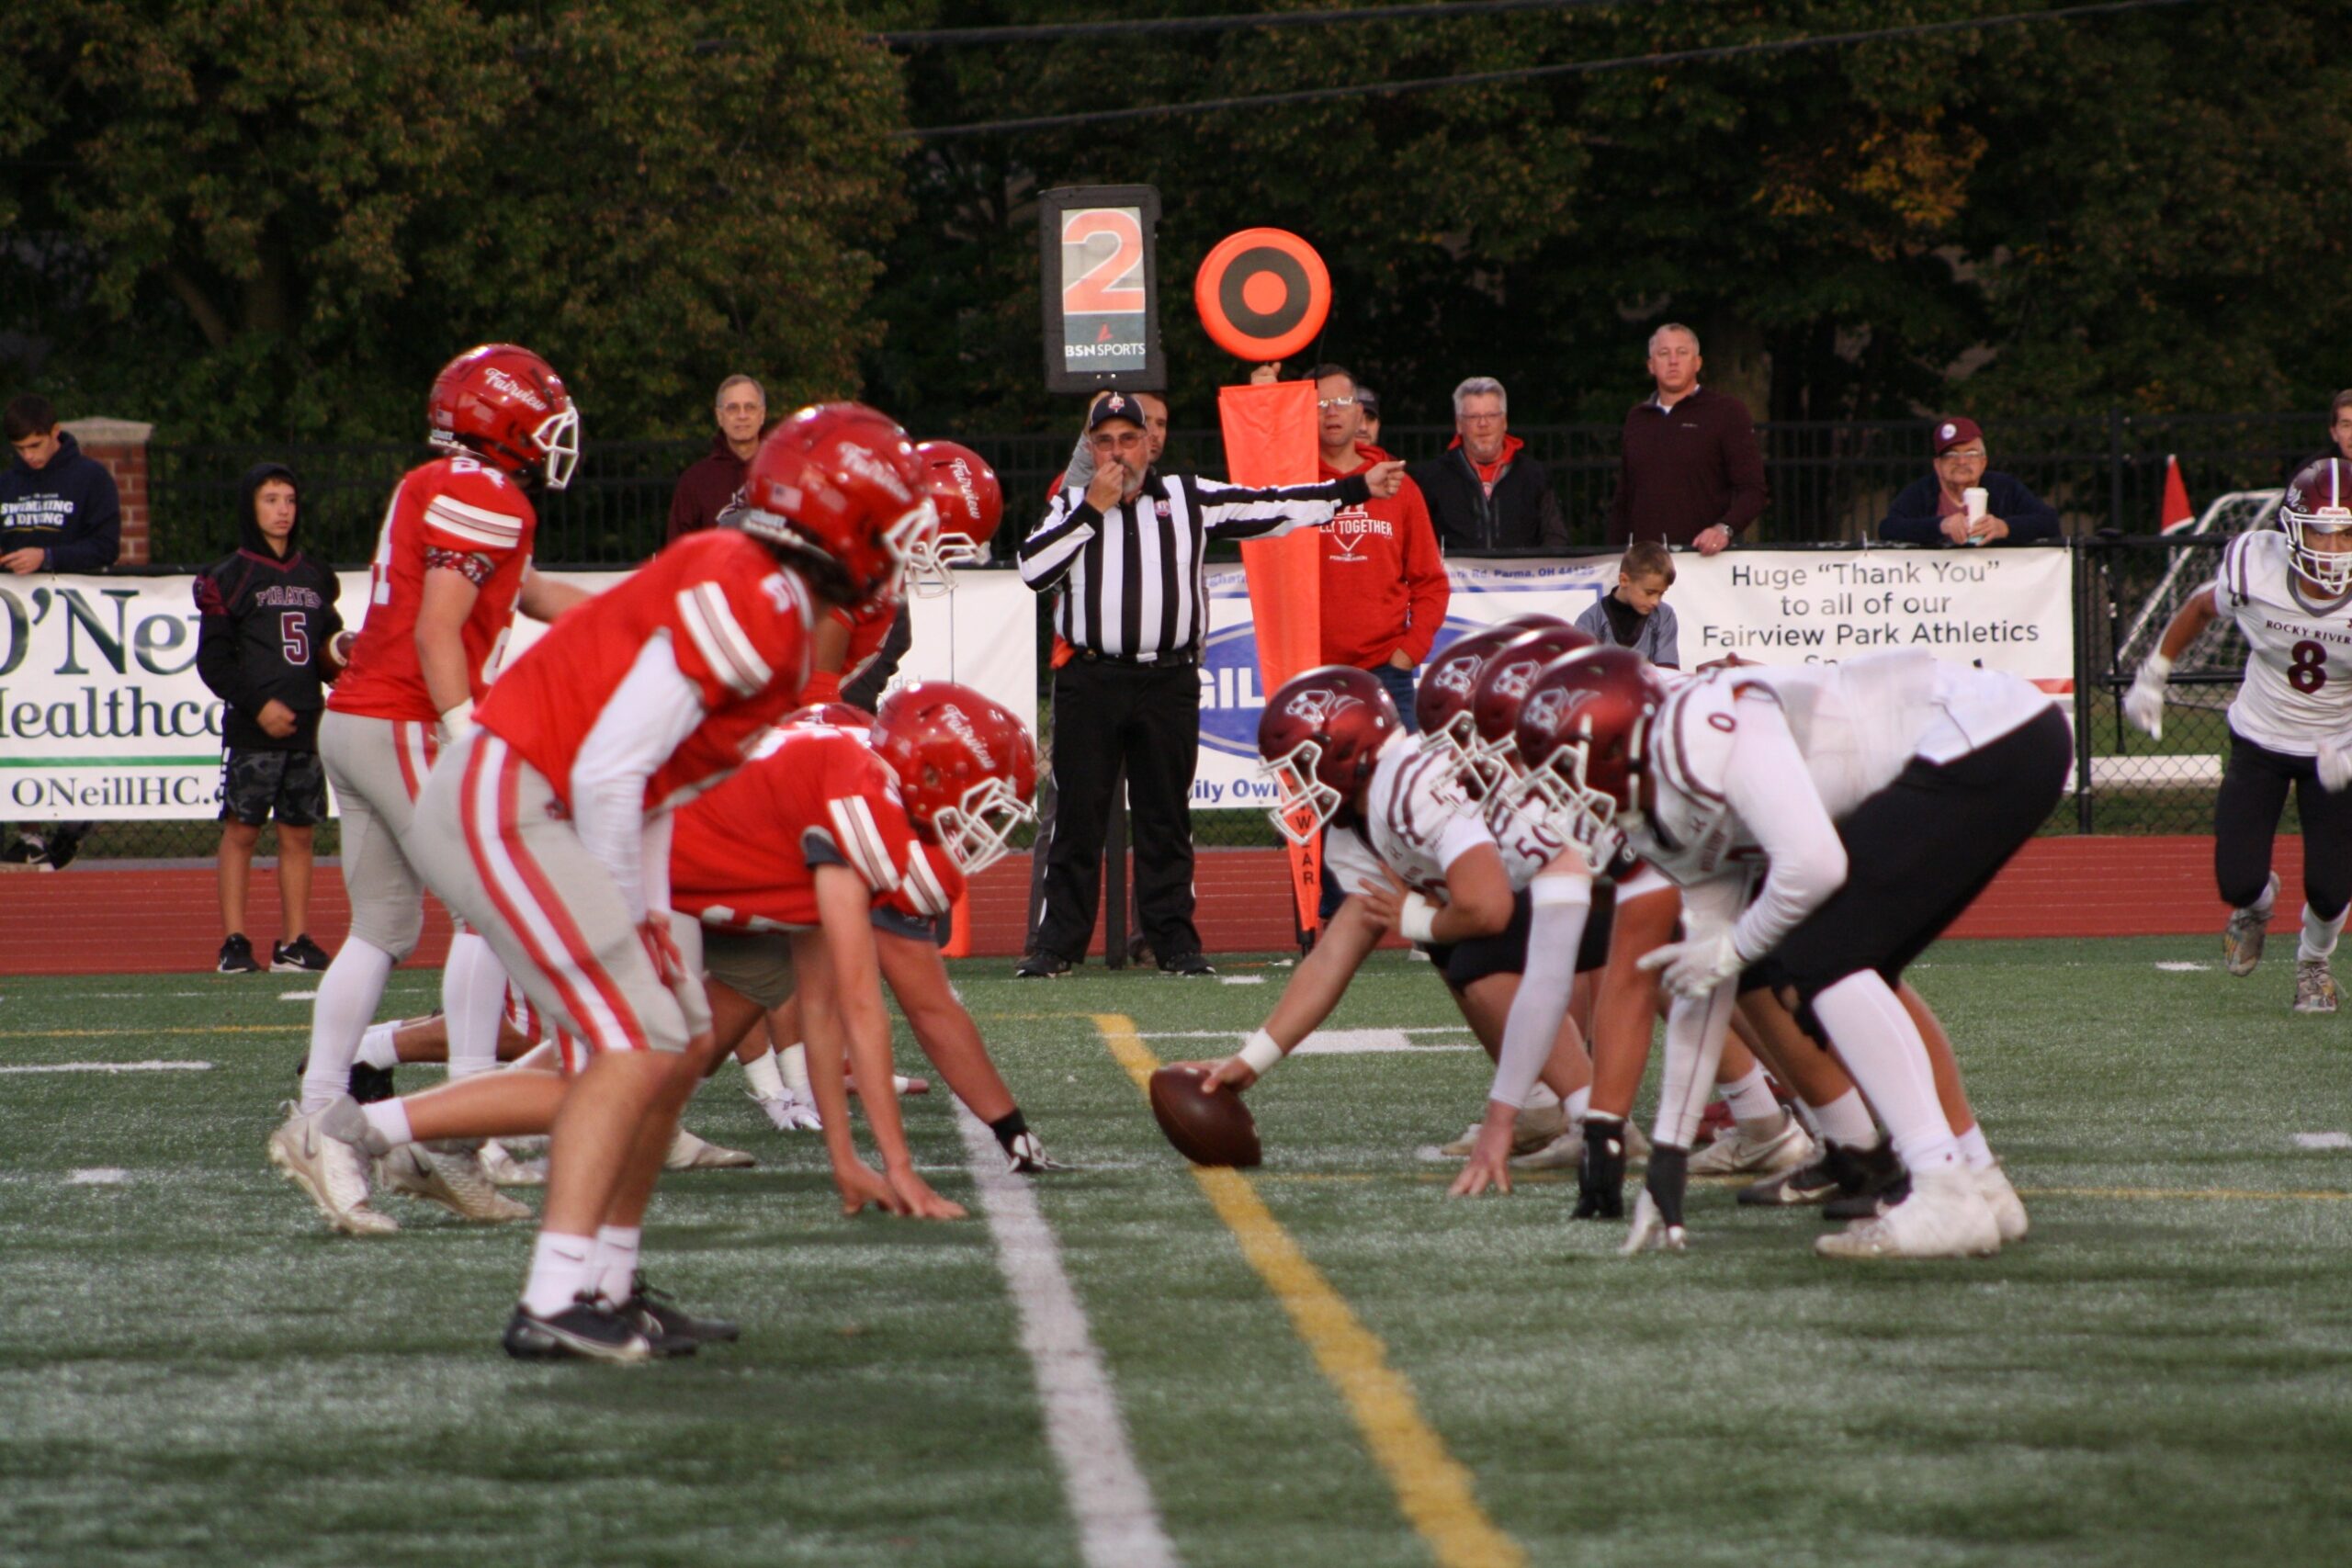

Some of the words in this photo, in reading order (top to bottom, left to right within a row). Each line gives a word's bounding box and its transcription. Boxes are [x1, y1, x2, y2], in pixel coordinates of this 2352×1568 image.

[1062, 209, 1146, 314] 2
[484, 367, 548, 412] Fairview
[950, 457, 981, 520] Fairview
[1339, 519, 1393, 537] TOGETHER
[1538, 568, 1555, 576] OH
[1732, 565, 1807, 591] Huge
[255, 585, 322, 609] PIRATES
[1781, 595, 1810, 615] to
[1821, 592, 1852, 615] all
[1864, 592, 1893, 615] of
[1904, 596, 1951, 614] our
[0, 588, 202, 676] 'Ne
[281, 611, 310, 665] 5
[1702, 624, 1826, 647] Fairview
[1837, 623, 1900, 646] Park
[1911, 620, 2040, 644] Athletics
[2266, 620, 2309, 637] ROCKY
[2314, 631, 2351, 645] RIVER
[2287, 640, 2328, 694] 8
[0, 686, 224, 739] ealthc
[941, 704, 996, 770] Fairview
[12, 775, 223, 807] ONeillHC.
[1192, 779, 1224, 803] ily
